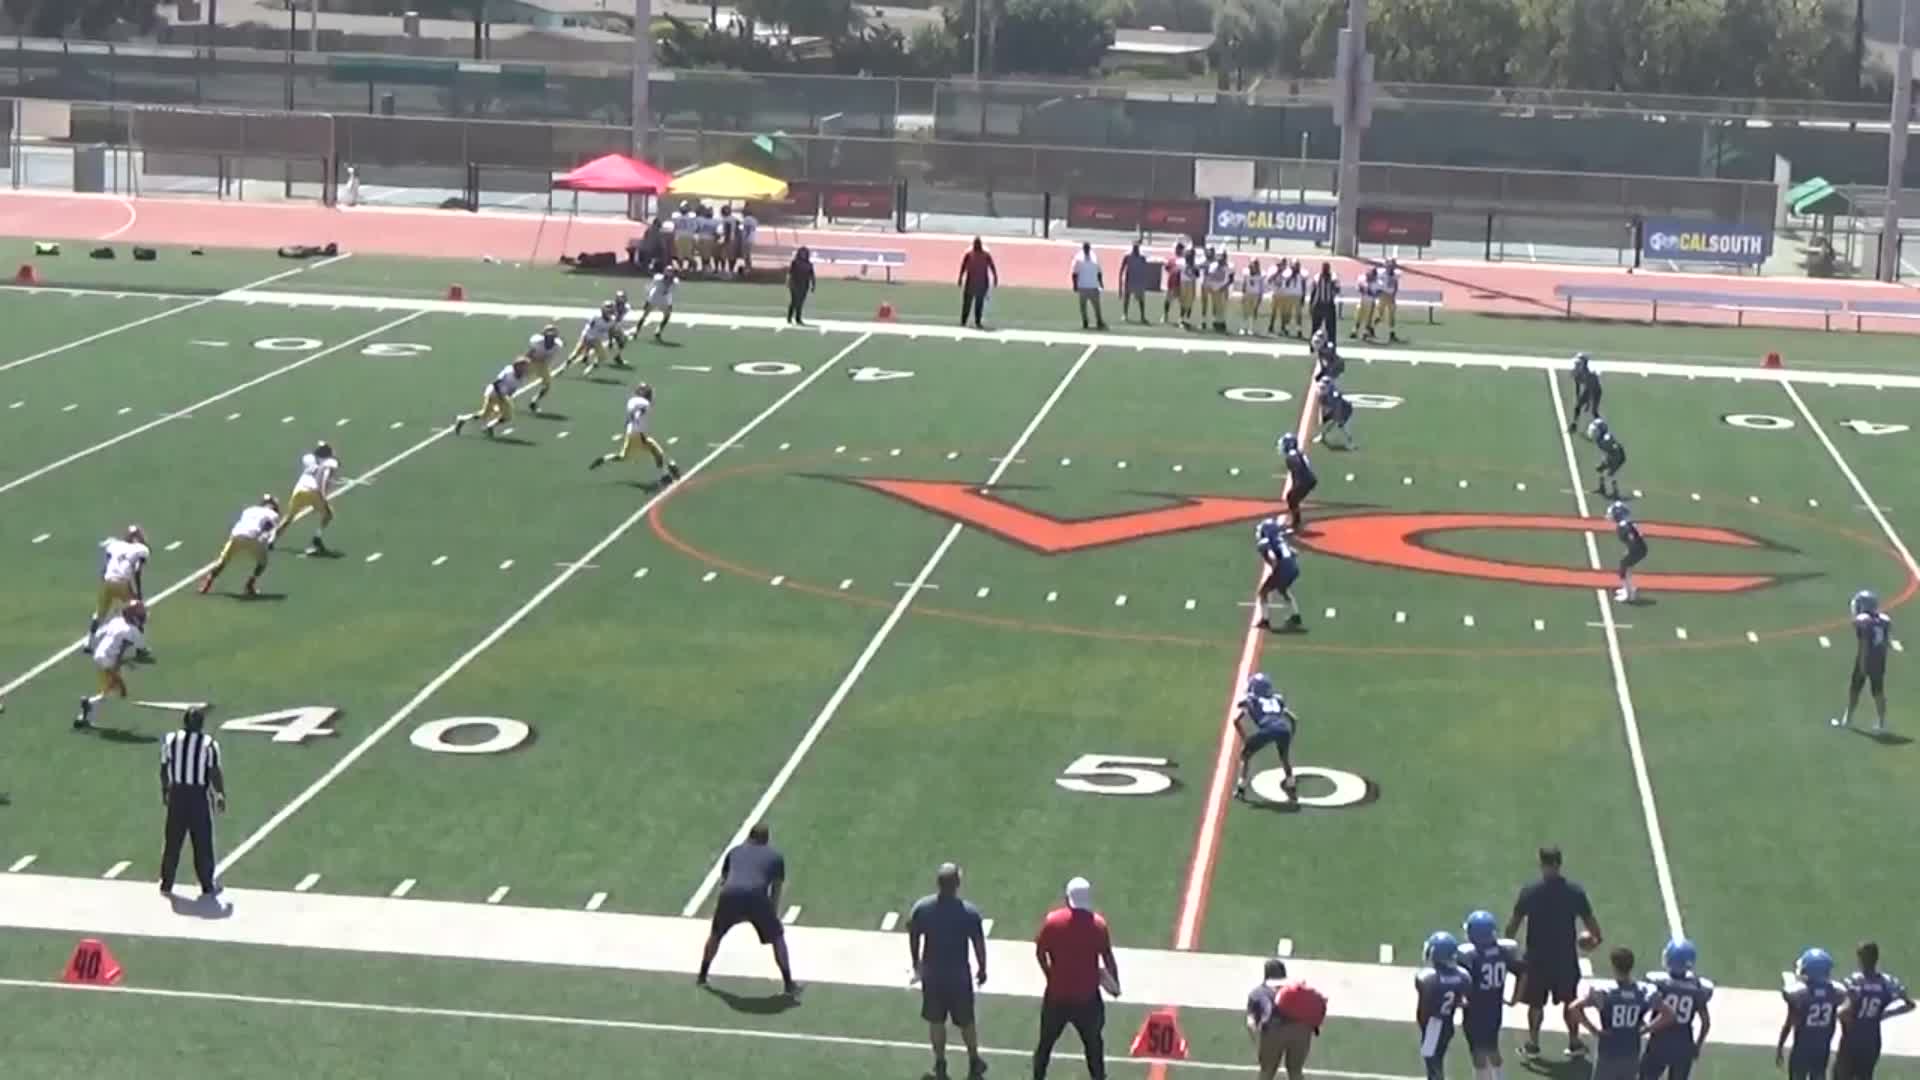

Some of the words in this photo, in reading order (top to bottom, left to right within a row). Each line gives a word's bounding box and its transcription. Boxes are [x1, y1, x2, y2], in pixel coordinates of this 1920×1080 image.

[1247, 209, 1327, 233] CALSOUTH
[1680, 231, 1762, 255] CALSOUTH
[73, 947, 102, 980] 40
[1479, 962, 1506, 990] 30
[1440, 990, 1456, 1015] 2
[1805, 1002, 1834, 1028] 23
[1611, 1003, 1641, 1028] 80
[1148, 1022, 1174, 1055] 50
